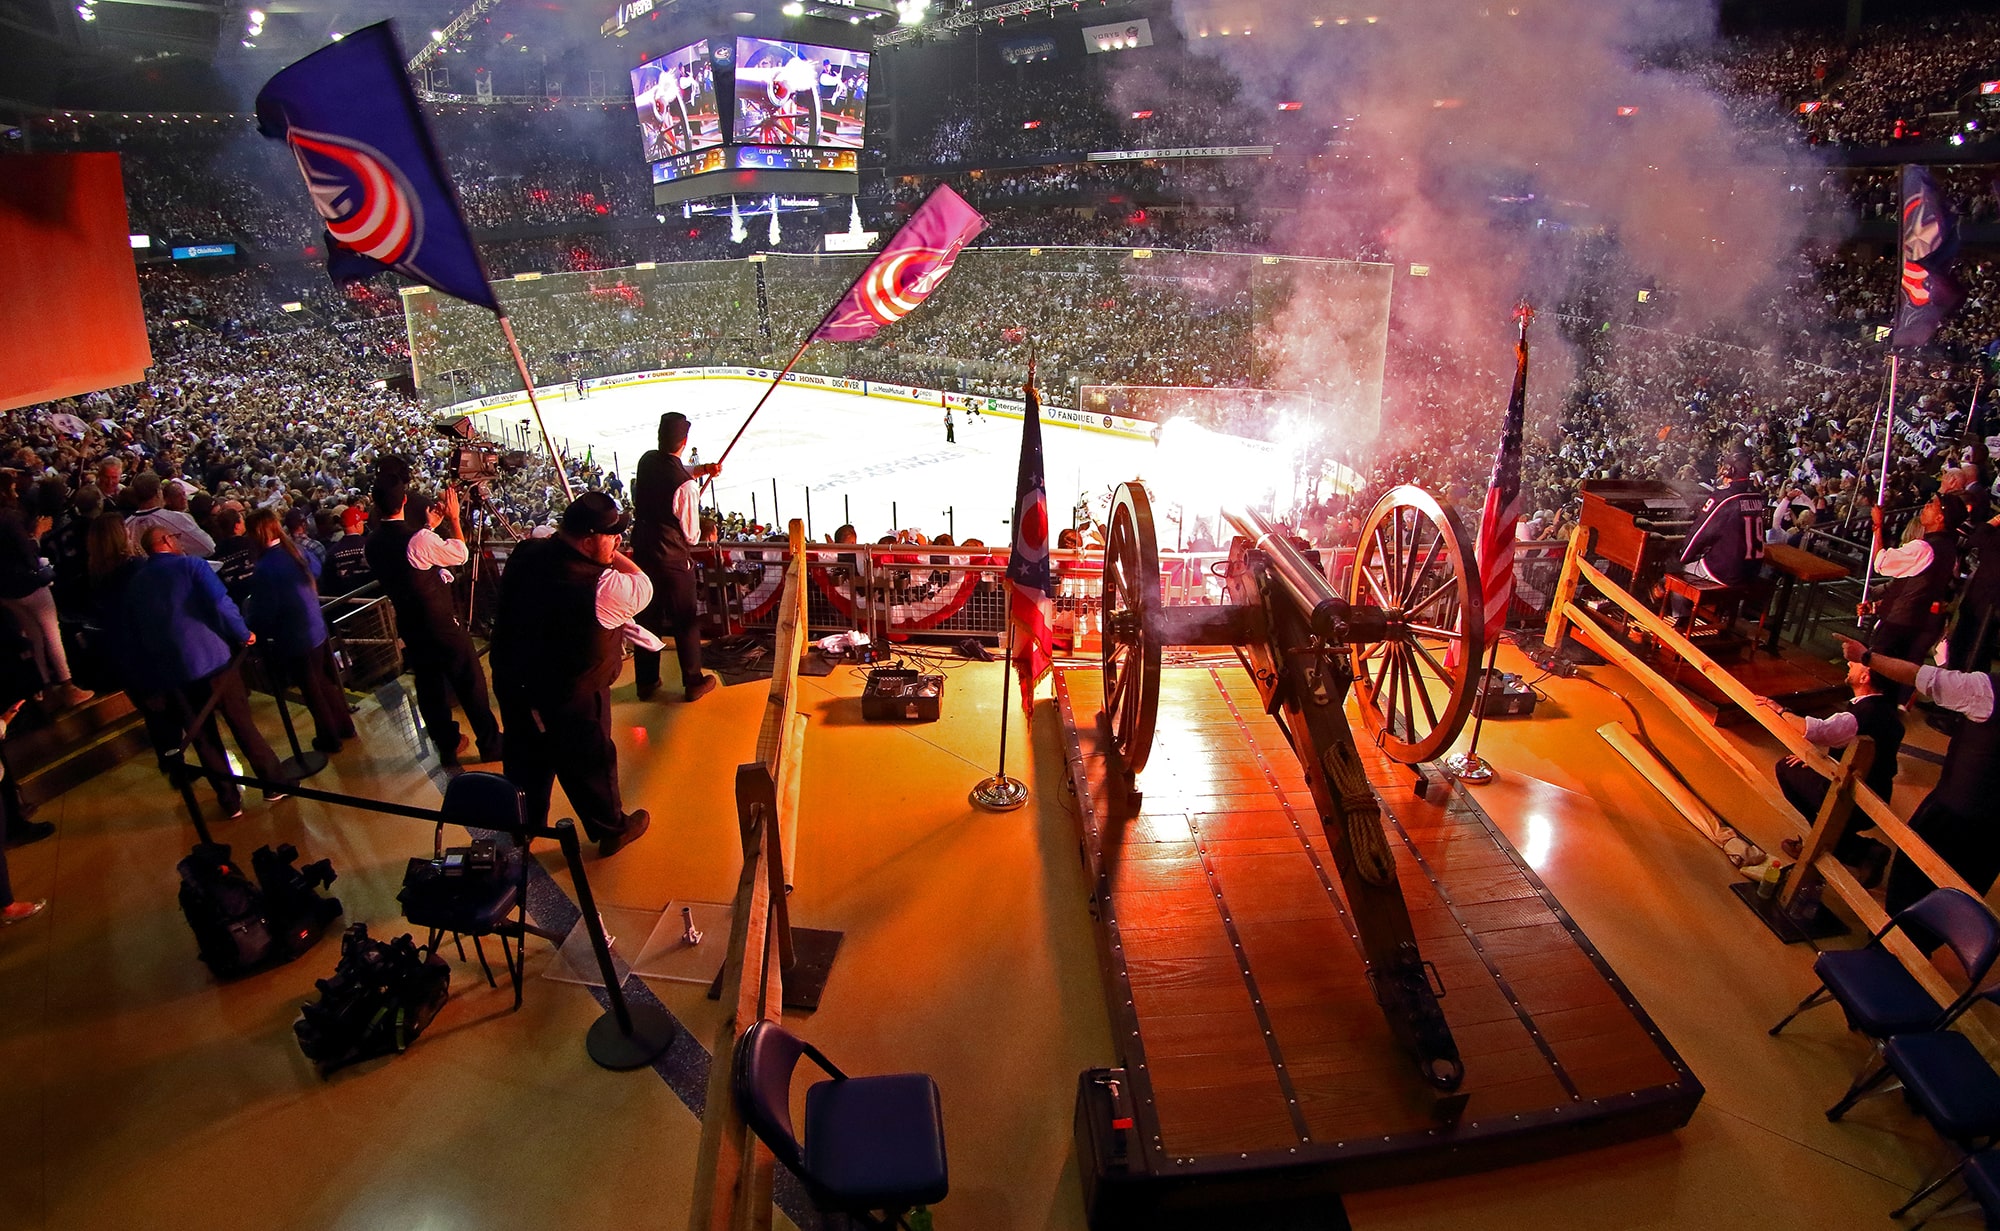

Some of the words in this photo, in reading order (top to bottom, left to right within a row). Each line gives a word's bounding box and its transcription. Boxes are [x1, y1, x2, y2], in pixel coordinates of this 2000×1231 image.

[624, 0, 653, 23] Arena
[1093, 32, 1120, 40] VORYS
[1014, 42, 1054, 57] OhioHealth
[791, 148, 813, 158] 11:14
[1119, 151, 1150, 159] LET'S
[1176, 148, 1234, 156] JACKETS
[767, 155, 774, 165] 0
[828, 158, 834, 168] 2
[664, 169, 669, 179] 0
[699, 160, 705, 170] 2
[781, 198, 820, 207] Nationwide
[772, 372, 796, 381] GCO
[799, 375, 826, 385] HONDA
[832, 379, 860, 390] DISCOVER
[878, 386, 906, 396] MassMutual
[1058, 411, 1095, 424] FANDUEL
